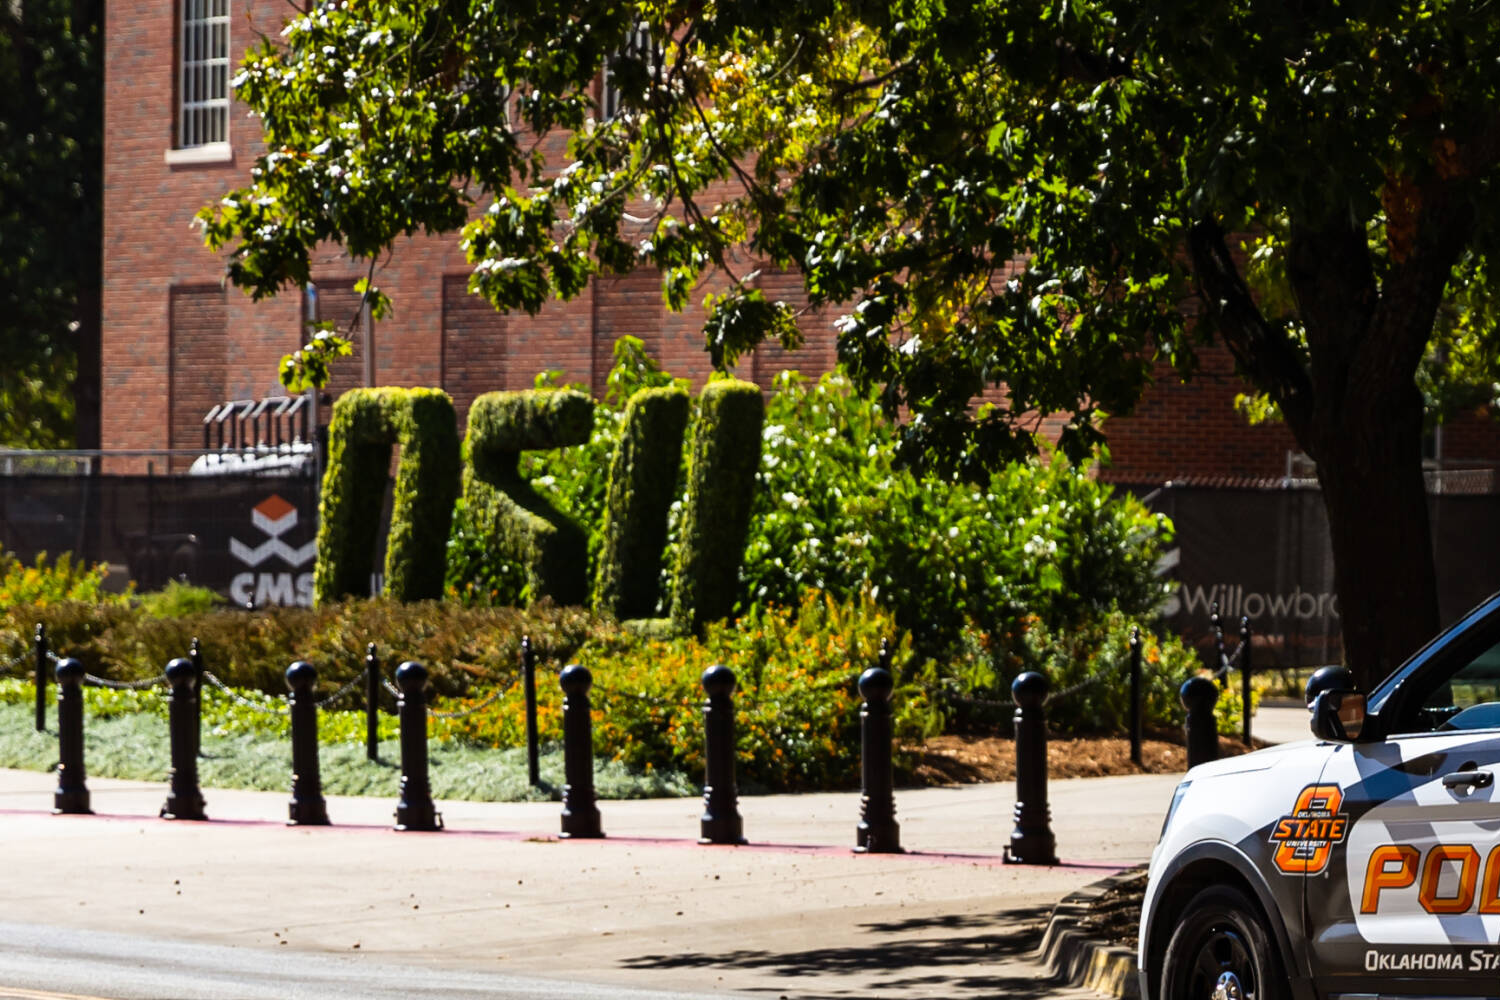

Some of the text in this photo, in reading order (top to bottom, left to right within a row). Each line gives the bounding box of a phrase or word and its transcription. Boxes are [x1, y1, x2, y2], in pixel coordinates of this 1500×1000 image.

[229, 572, 316, 608] CMS
[1274, 819, 1345, 838] STATE
[1365, 950, 1464, 971] OKLAHOMA
